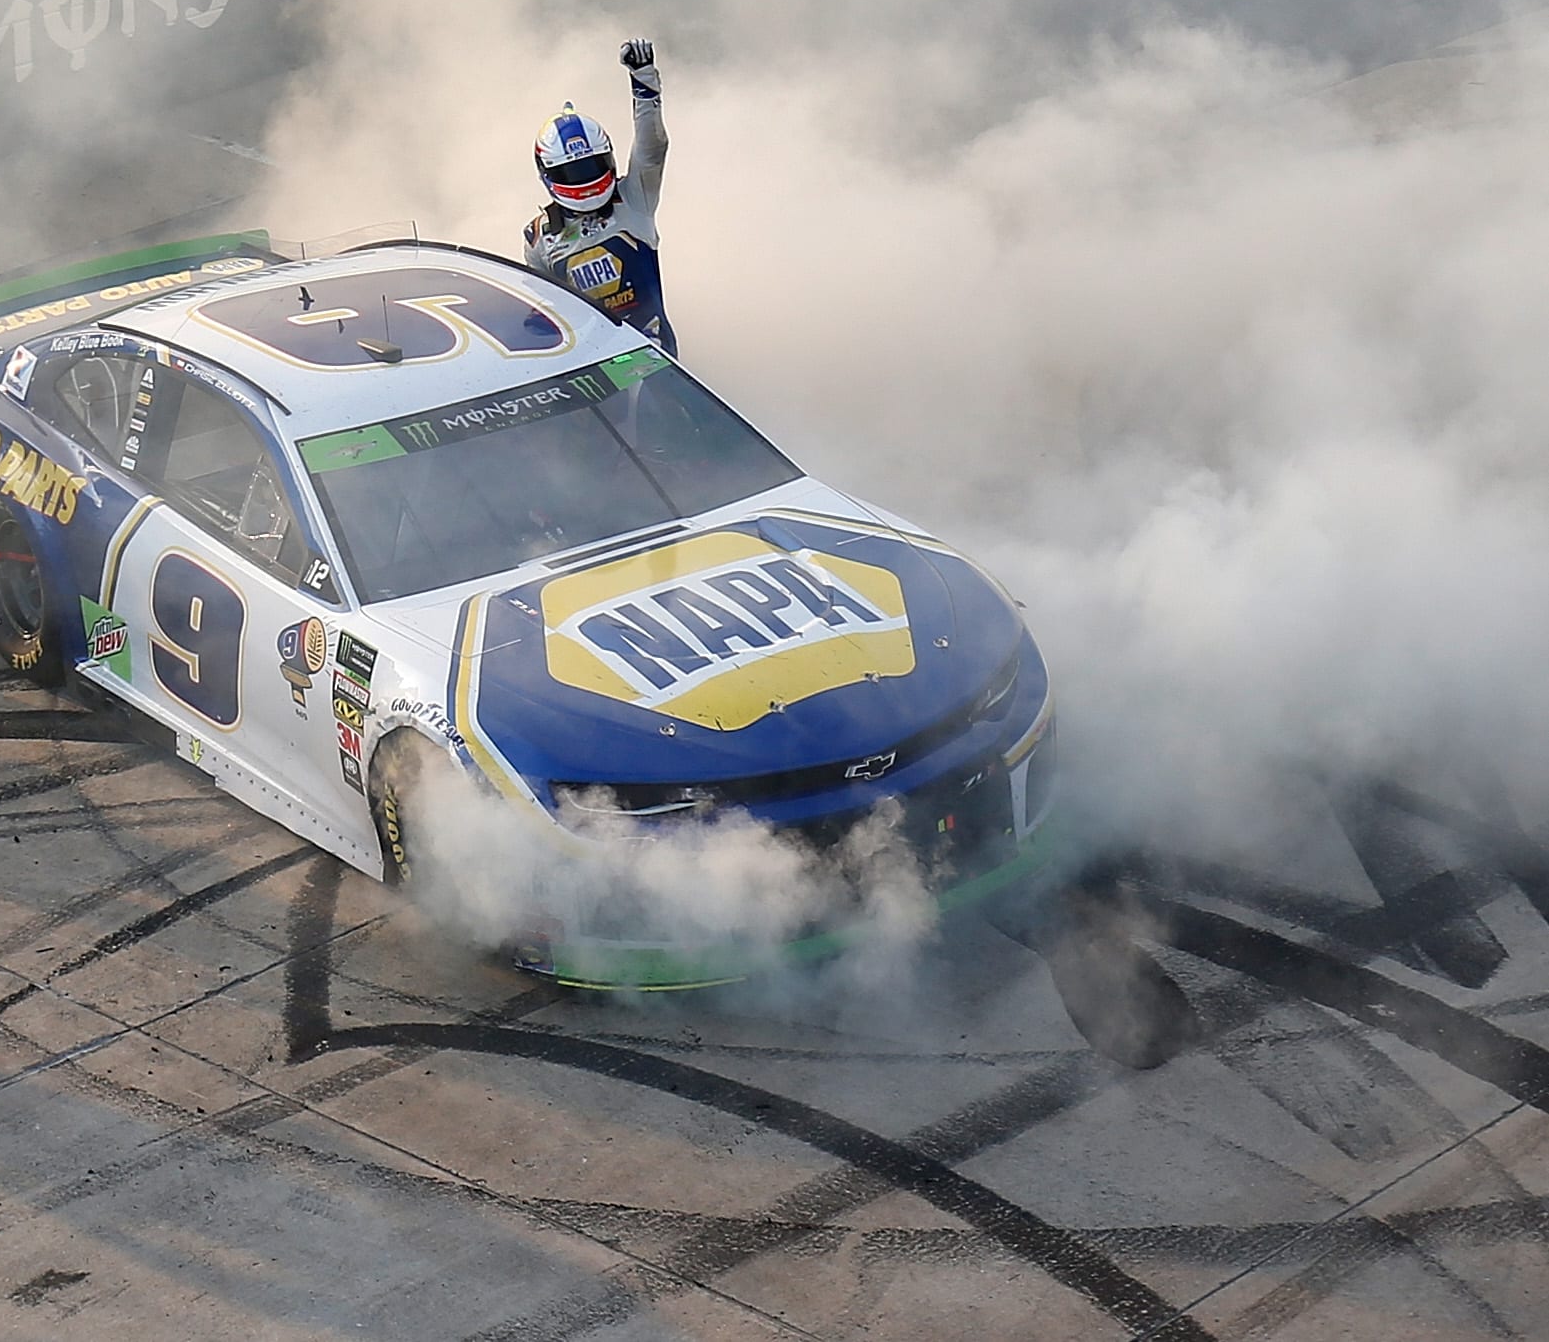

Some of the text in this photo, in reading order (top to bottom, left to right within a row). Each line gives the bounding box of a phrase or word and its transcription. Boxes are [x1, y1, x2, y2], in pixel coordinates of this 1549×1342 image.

[99, 270, 193, 303] AUTO
[571, 256, 617, 291] NAPA
[603, 288, 635, 310] PARTS
[79, 335, 101, 350] Blue
[101, 332, 125, 348] Book
[442, 386, 572, 431] MONSTER
[484, 408, 553, 433] ENERGY
[148, 545, 250, 734] 9
[577, 557, 883, 692] NAPA
[282, 629, 298, 660] 9
[337, 721, 362, 761] 3M
